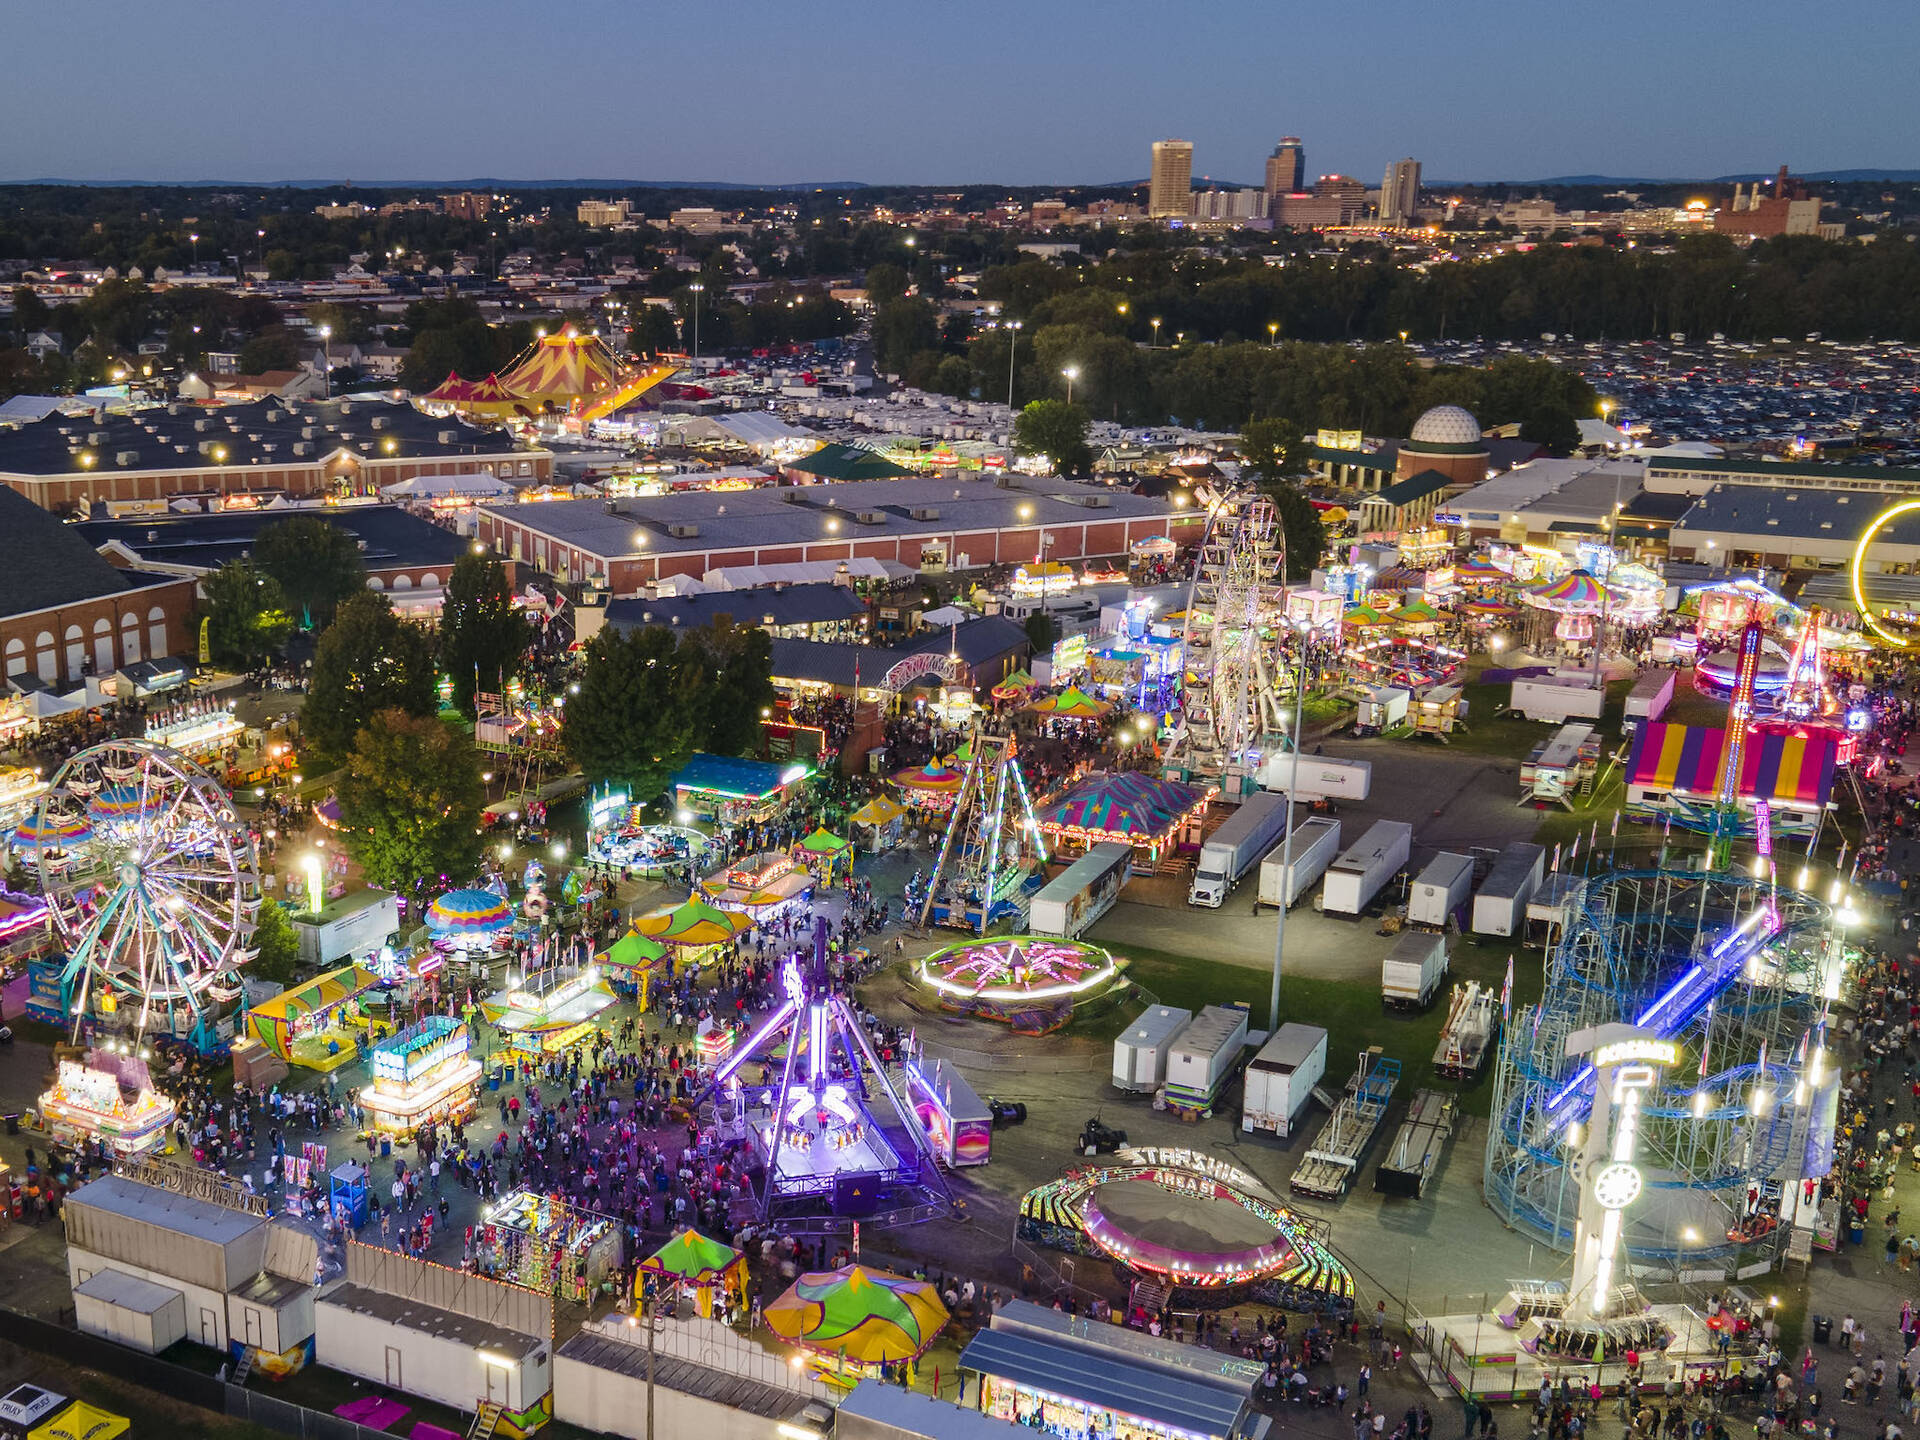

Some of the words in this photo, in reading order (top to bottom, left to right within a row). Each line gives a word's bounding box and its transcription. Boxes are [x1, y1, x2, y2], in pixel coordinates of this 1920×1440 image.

[1129, 1146, 1246, 1186] STARSHIP
[1, 1403, 22, 1416] TRULY
[29, 1396, 50, 1413] TRULY
